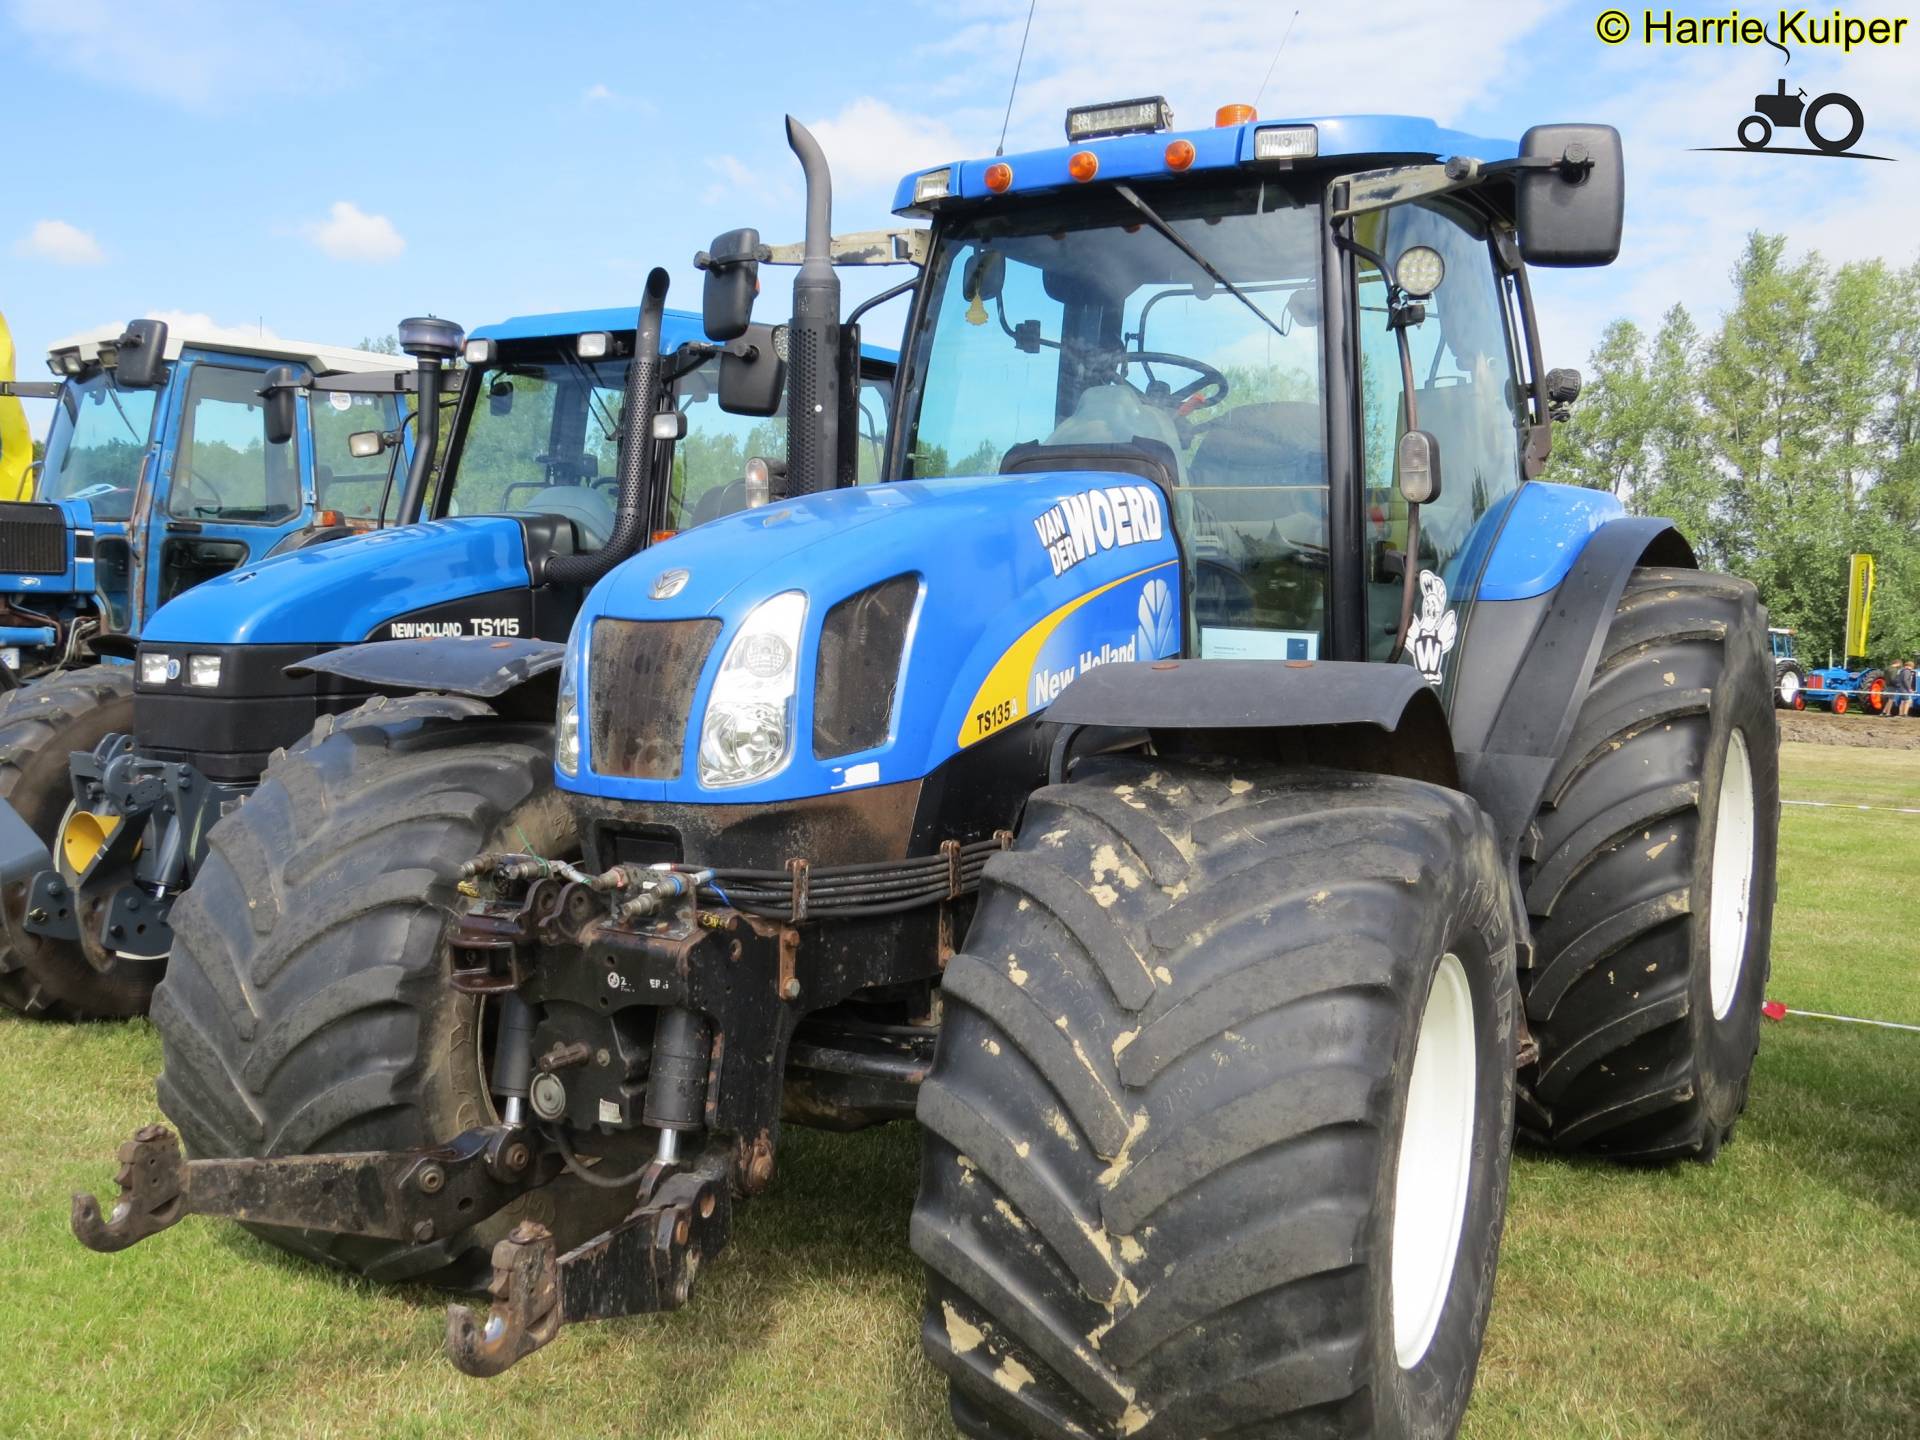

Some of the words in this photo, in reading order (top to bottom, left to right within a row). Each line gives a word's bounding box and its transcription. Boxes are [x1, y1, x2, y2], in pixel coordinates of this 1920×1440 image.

[1033, 504, 1066, 548] VAN
[1060, 486, 1162, 561] WOERD
[1048, 535, 1077, 578] DER
[391, 623, 414, 638] NEW
[415, 622, 462, 637] HOLLAND
[470, 618, 520, 636] TS115
[1416, 638, 1441, 672] W
[1035, 667, 1075, 706] New
